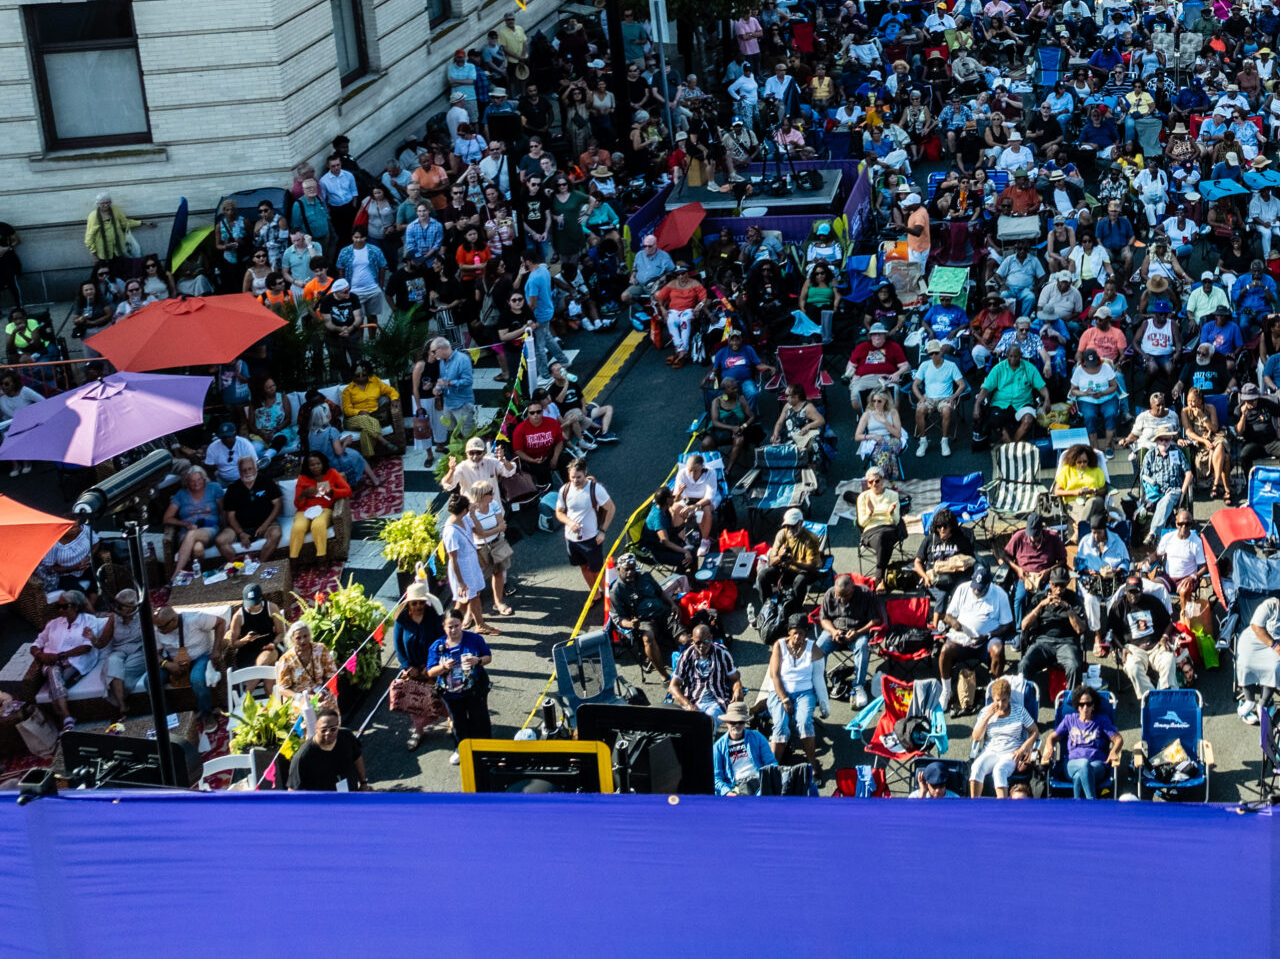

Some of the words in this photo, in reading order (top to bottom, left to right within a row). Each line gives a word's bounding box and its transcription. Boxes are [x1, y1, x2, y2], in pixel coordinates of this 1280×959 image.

[1147, 333, 1157, 341] NEW
[1159, 333, 1171, 341] YORK
[1151, 339, 1168, 348] 33
[931, 544, 958, 552] KAMALA
